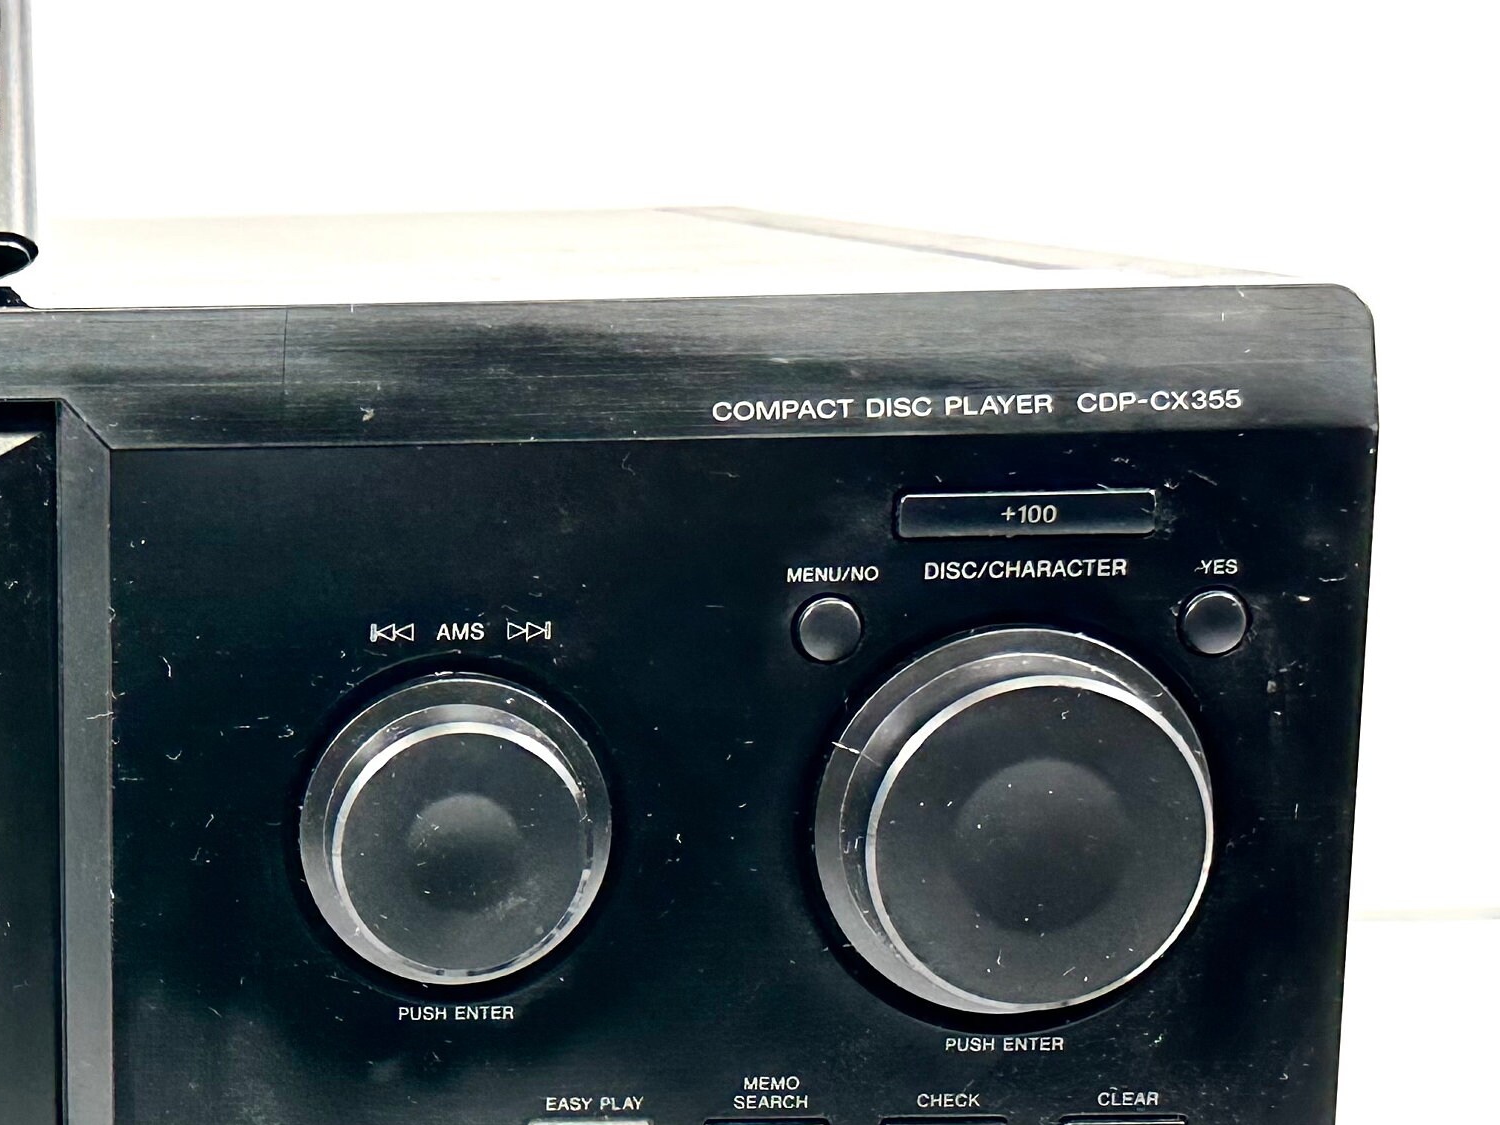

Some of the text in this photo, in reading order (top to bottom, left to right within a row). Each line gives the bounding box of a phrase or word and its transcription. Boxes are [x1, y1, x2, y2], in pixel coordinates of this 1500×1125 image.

[711, 389, 1243, 422] COMPACT DISC PLAYER CDP-CX355
[1000, 504, 1058, 524] +100
[924, 559, 1128, 582] DISC/CHARACTER
[1200, 559, 1238, 575] YES
[786, 566, 880, 584] MENU/NO
[436, 622, 485, 641] AMS
[398, 1006, 514, 1021] PUSH ENTER
[945, 1037, 1064, 1052] PUSH ENTER
[743, 1076, 800, 1091] MEMO
[545, 1096, 644, 1111] EASY PLAY
[733, 1095, 808, 1109] SEARCH
[916, 1093, 981, 1107] CHECK
[1097, 1092, 1159, 1106] CLEAR
